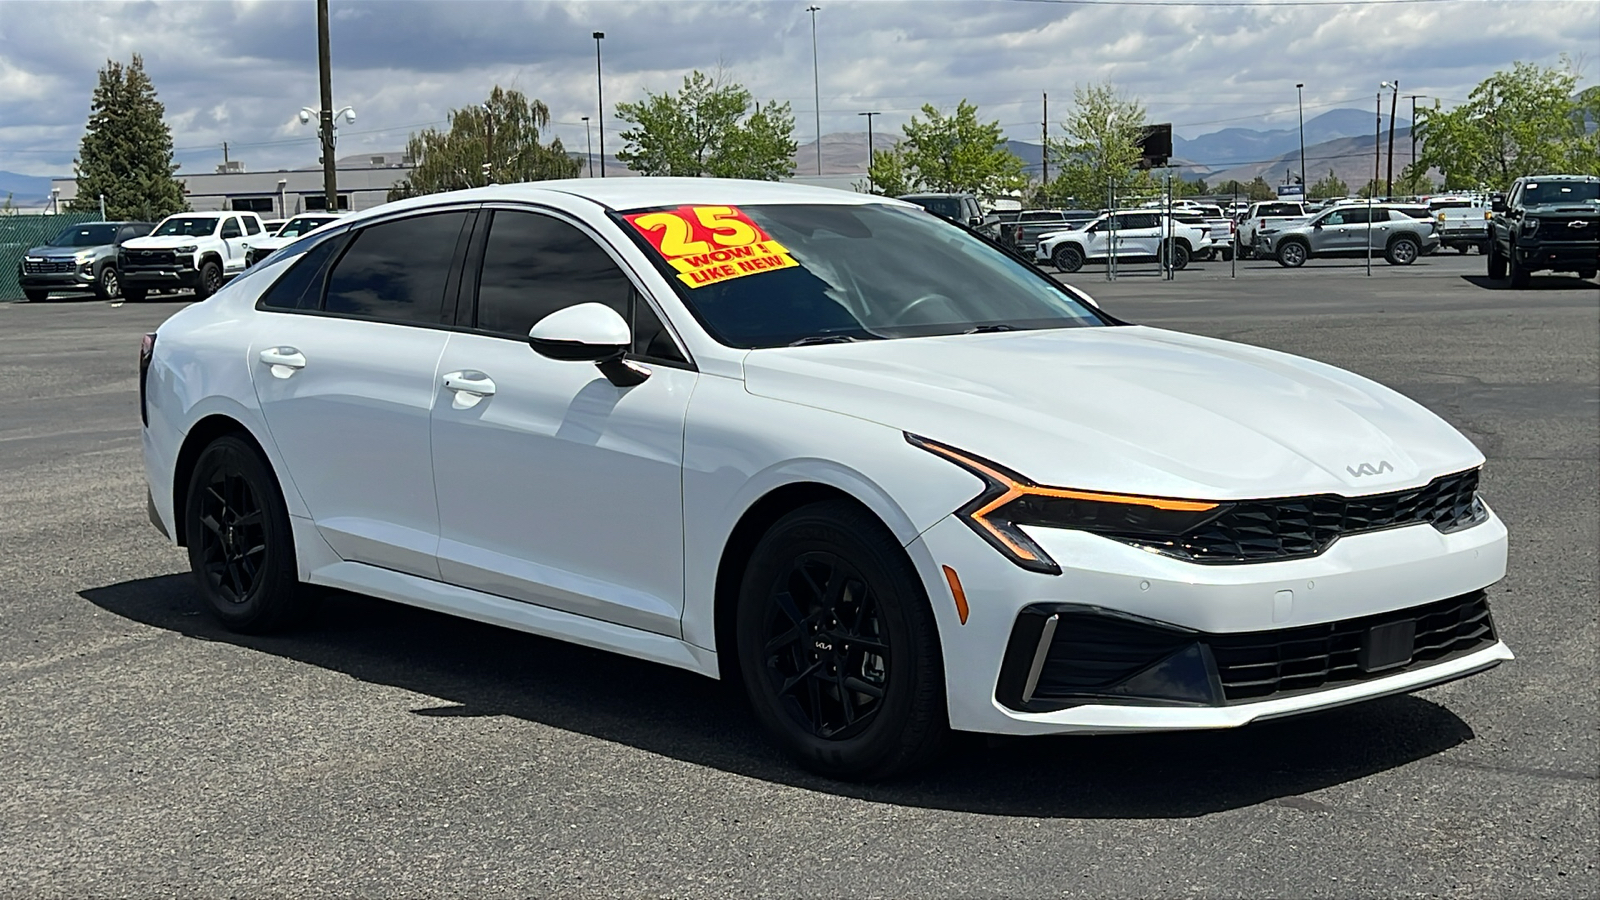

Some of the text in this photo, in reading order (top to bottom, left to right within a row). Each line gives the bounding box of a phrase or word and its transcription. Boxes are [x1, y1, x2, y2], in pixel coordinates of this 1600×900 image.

[634, 206, 761, 257] 25
[685, 245, 754, 267] WOW
[690, 256, 784, 284] LIKE NEW
[1346, 460, 1394, 477] KIA
